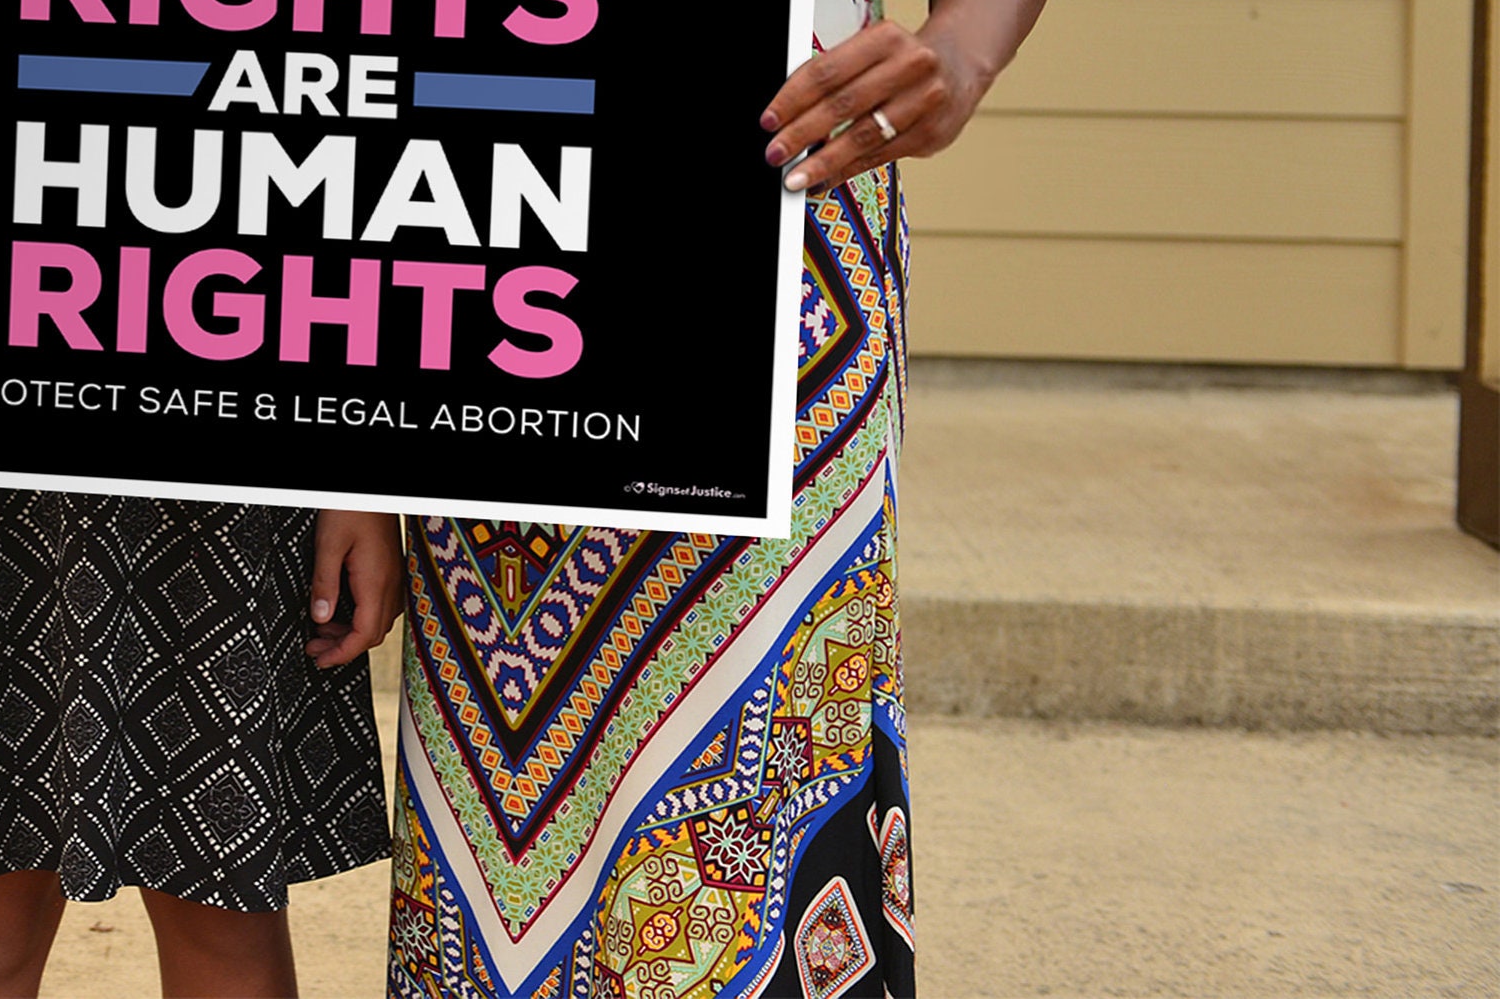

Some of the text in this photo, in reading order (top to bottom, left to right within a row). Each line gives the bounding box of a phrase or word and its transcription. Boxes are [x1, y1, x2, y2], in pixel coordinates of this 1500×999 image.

[207, 49, 399, 120] ARE
[12, 120, 593, 253] HUMAN
[8, 240, 584, 379] RIGHTS
[139, 386, 239, 419] SAFE
[254, 393, 277, 421] &
[294, 395, 419, 429] LEGAL
[429, 403, 641, 442] ABORTION
